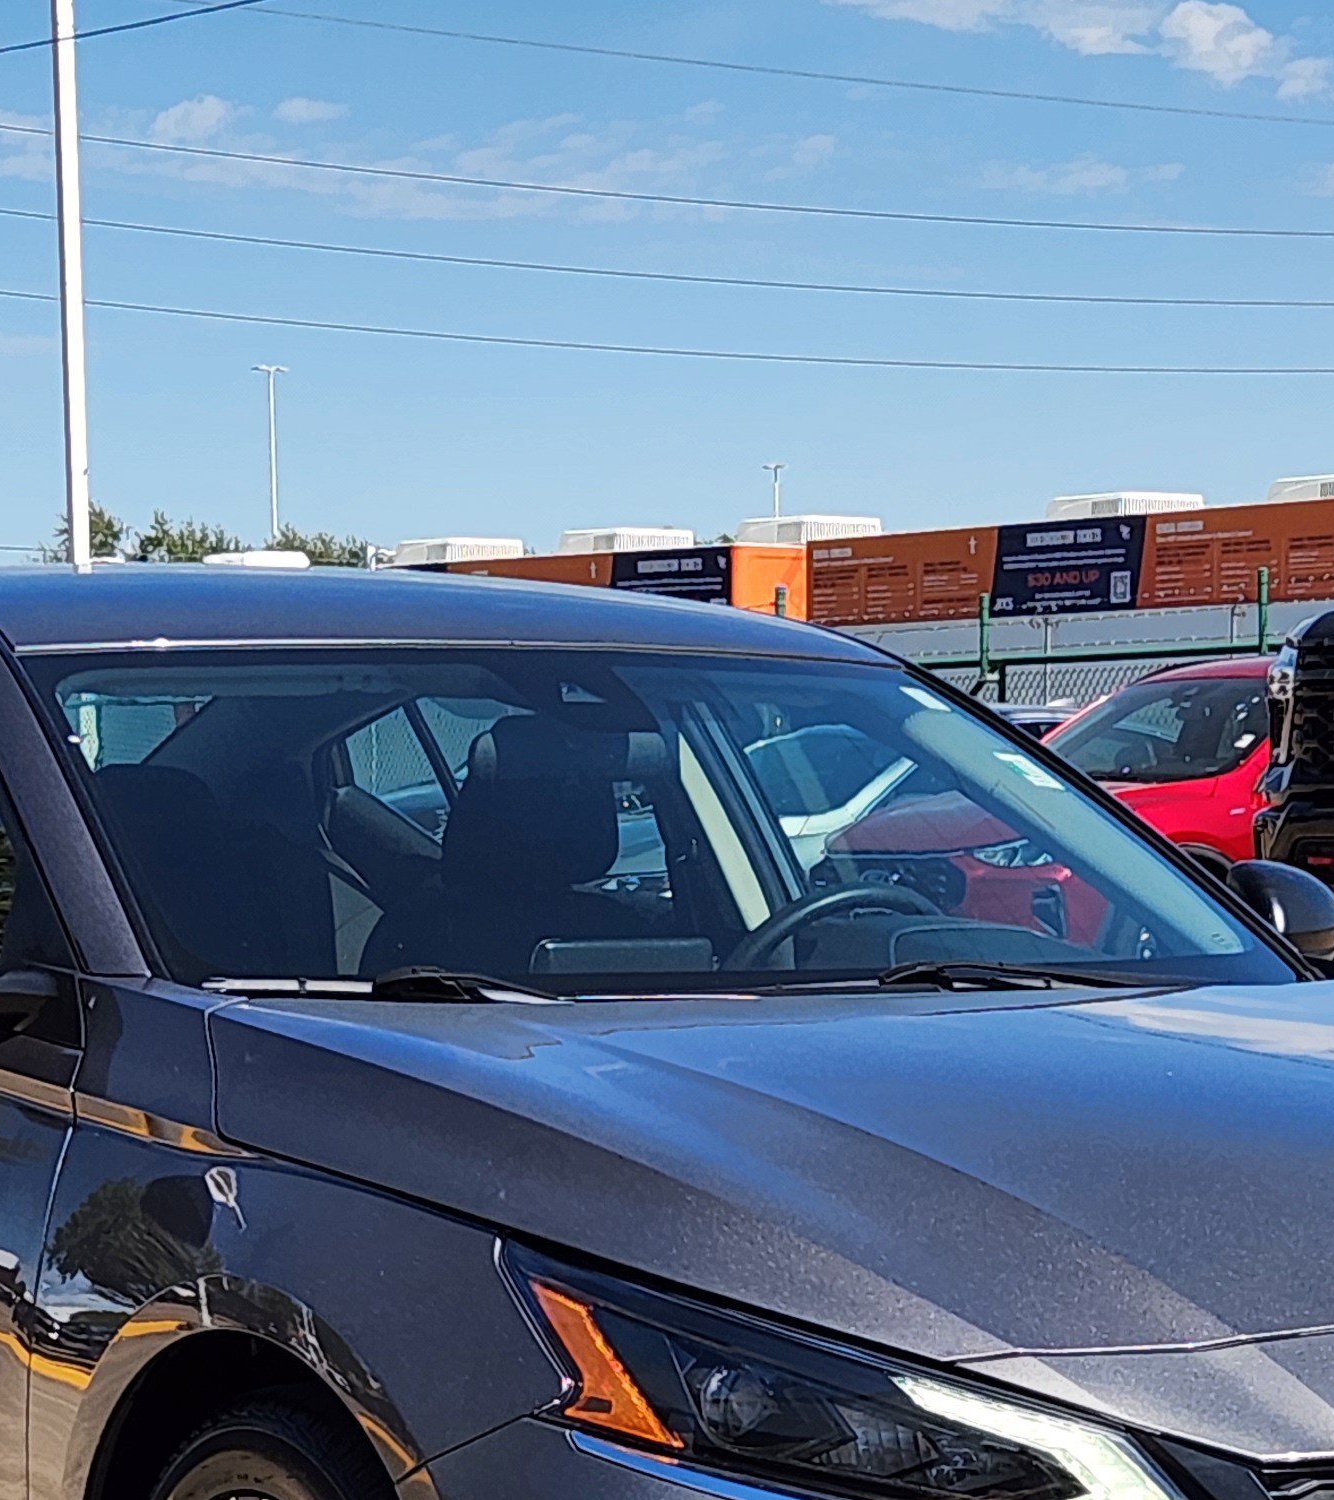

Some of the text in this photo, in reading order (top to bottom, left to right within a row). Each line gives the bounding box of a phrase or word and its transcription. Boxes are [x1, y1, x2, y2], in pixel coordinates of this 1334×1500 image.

[1026, 569, 1100, 588] $30 AND UP
